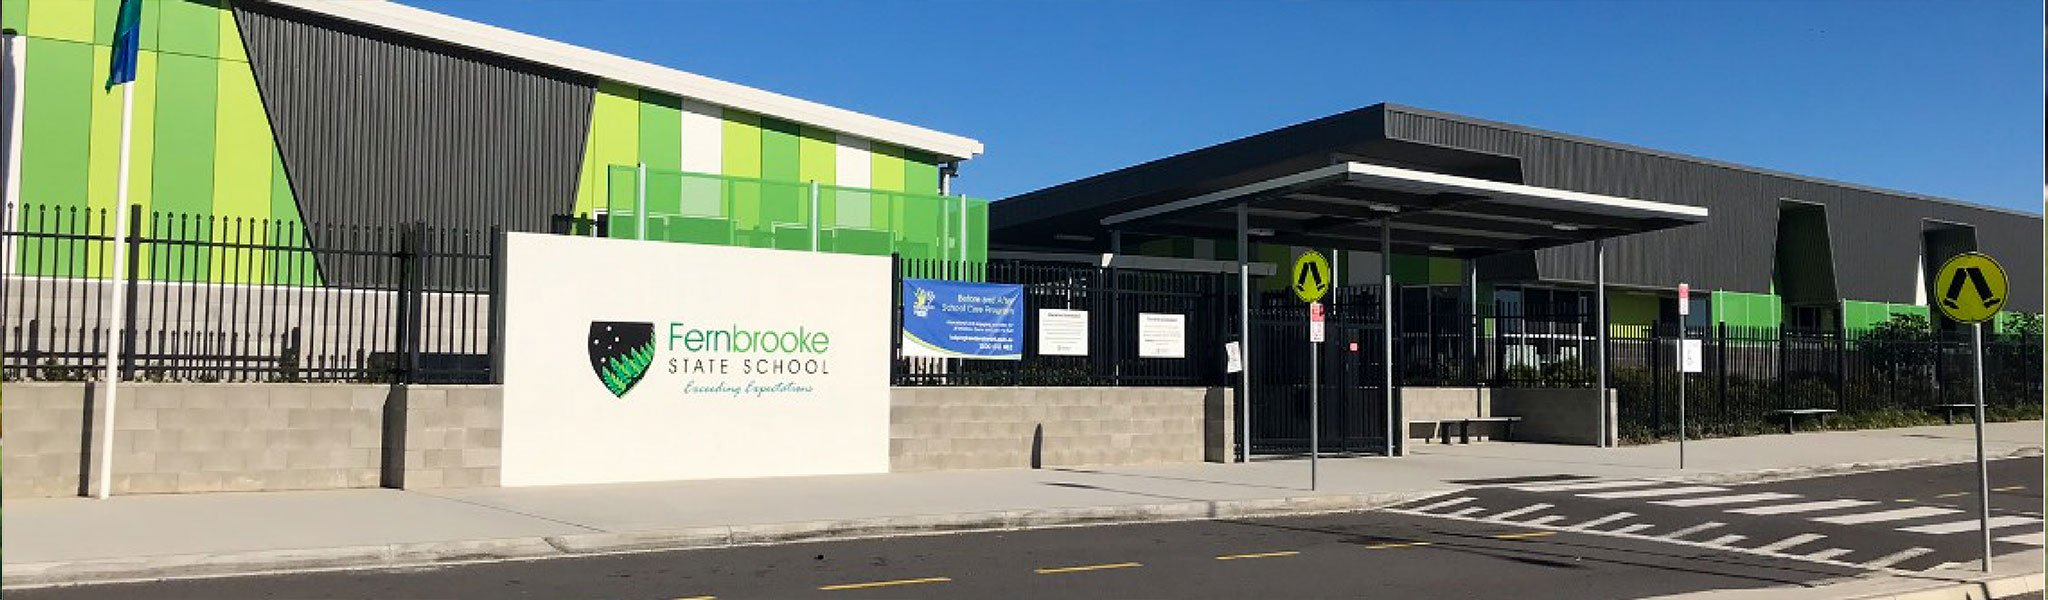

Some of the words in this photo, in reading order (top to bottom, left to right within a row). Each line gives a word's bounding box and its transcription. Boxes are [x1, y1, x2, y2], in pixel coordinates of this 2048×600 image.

[957, 294, 981, 303] Before
[942, 303, 966, 312] School
[967, 304, 984, 313] Care
[668, 322, 829, 353] Fernbrooke
[668, 358, 729, 374] STATE
[744, 358, 829, 374] SCHOOL
[684, 381, 742, 397] Exceeding
[744, 381, 813, 397] Expectations
